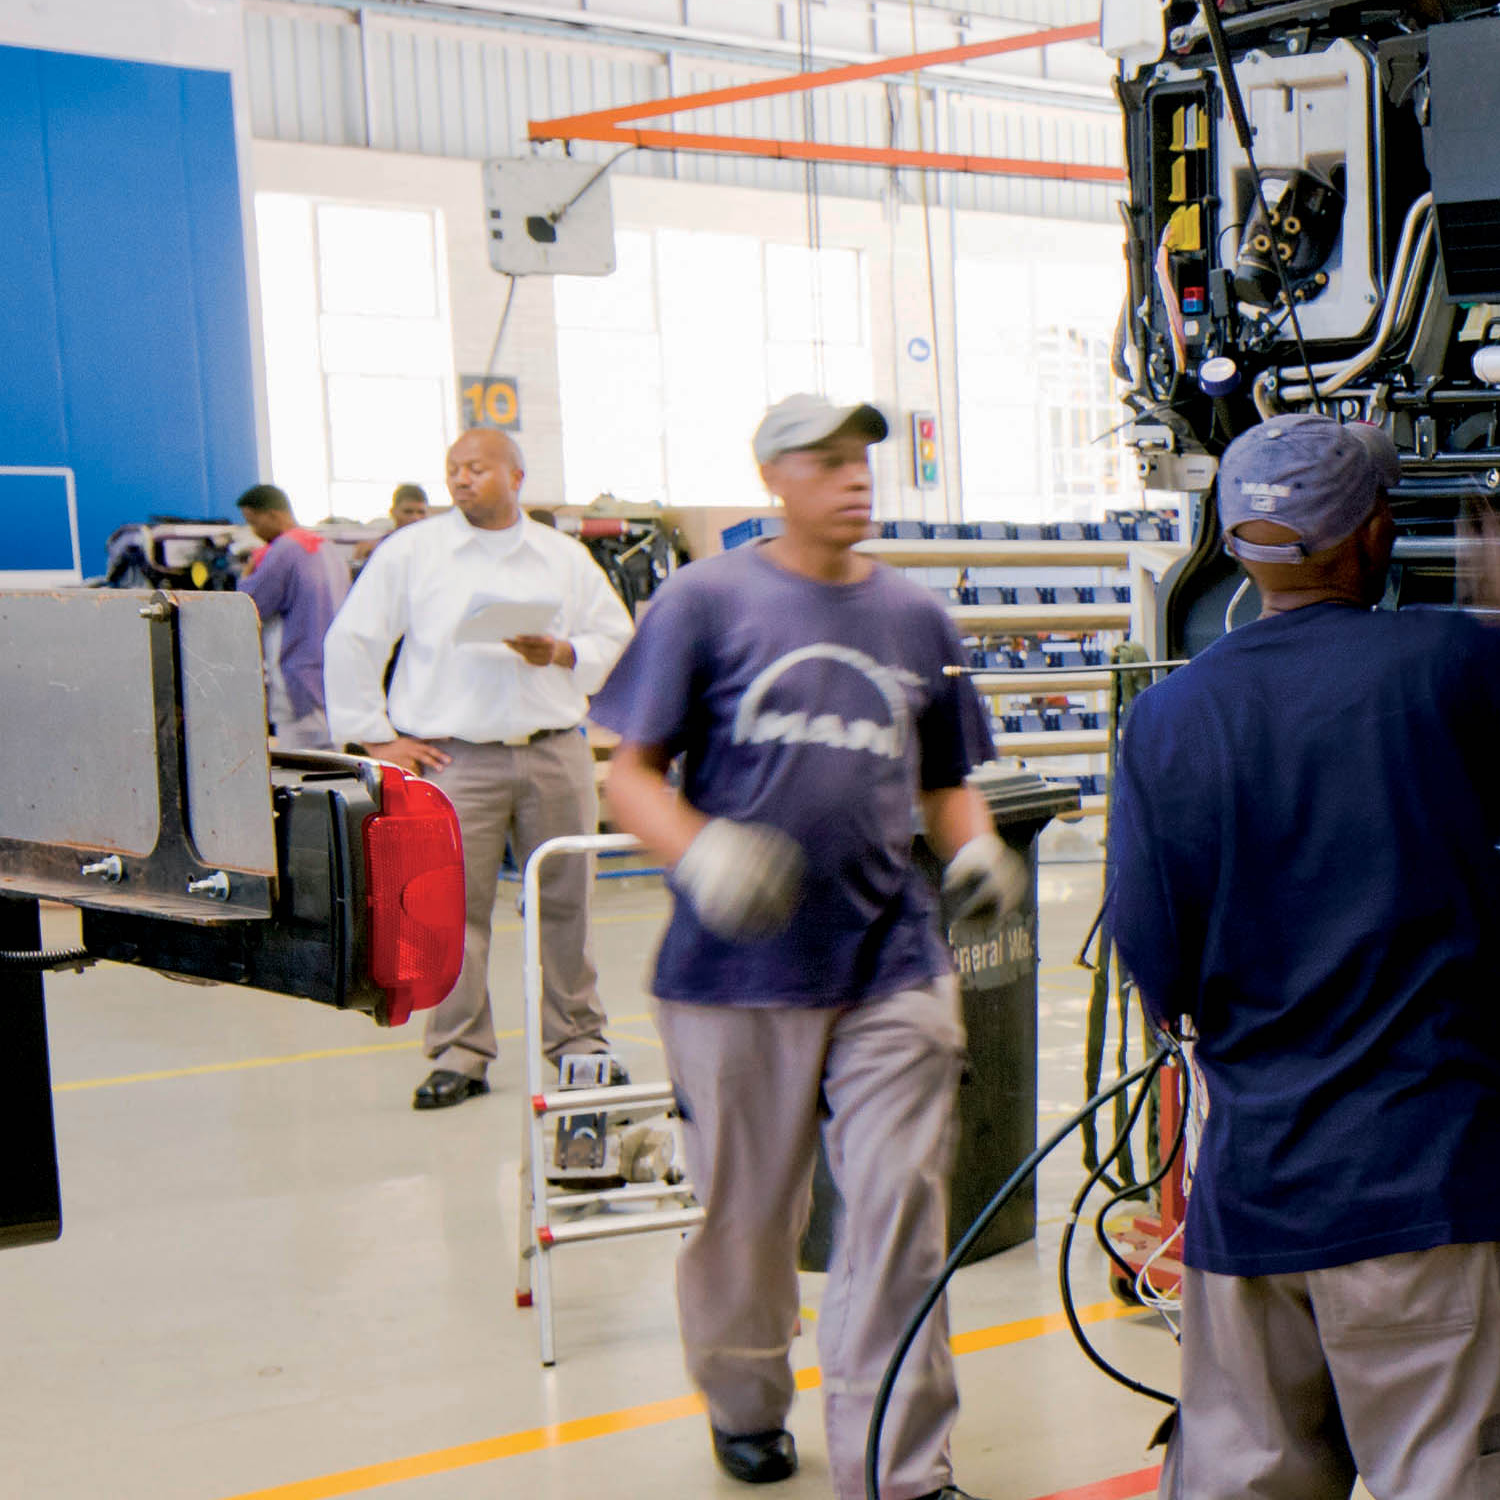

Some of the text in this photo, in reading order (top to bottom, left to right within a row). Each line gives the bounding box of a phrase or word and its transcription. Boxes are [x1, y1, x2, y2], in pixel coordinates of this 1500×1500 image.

[463, 383, 518, 424] 10
[749, 711, 905, 759] MAN
[948, 925, 1004, 973] neral
